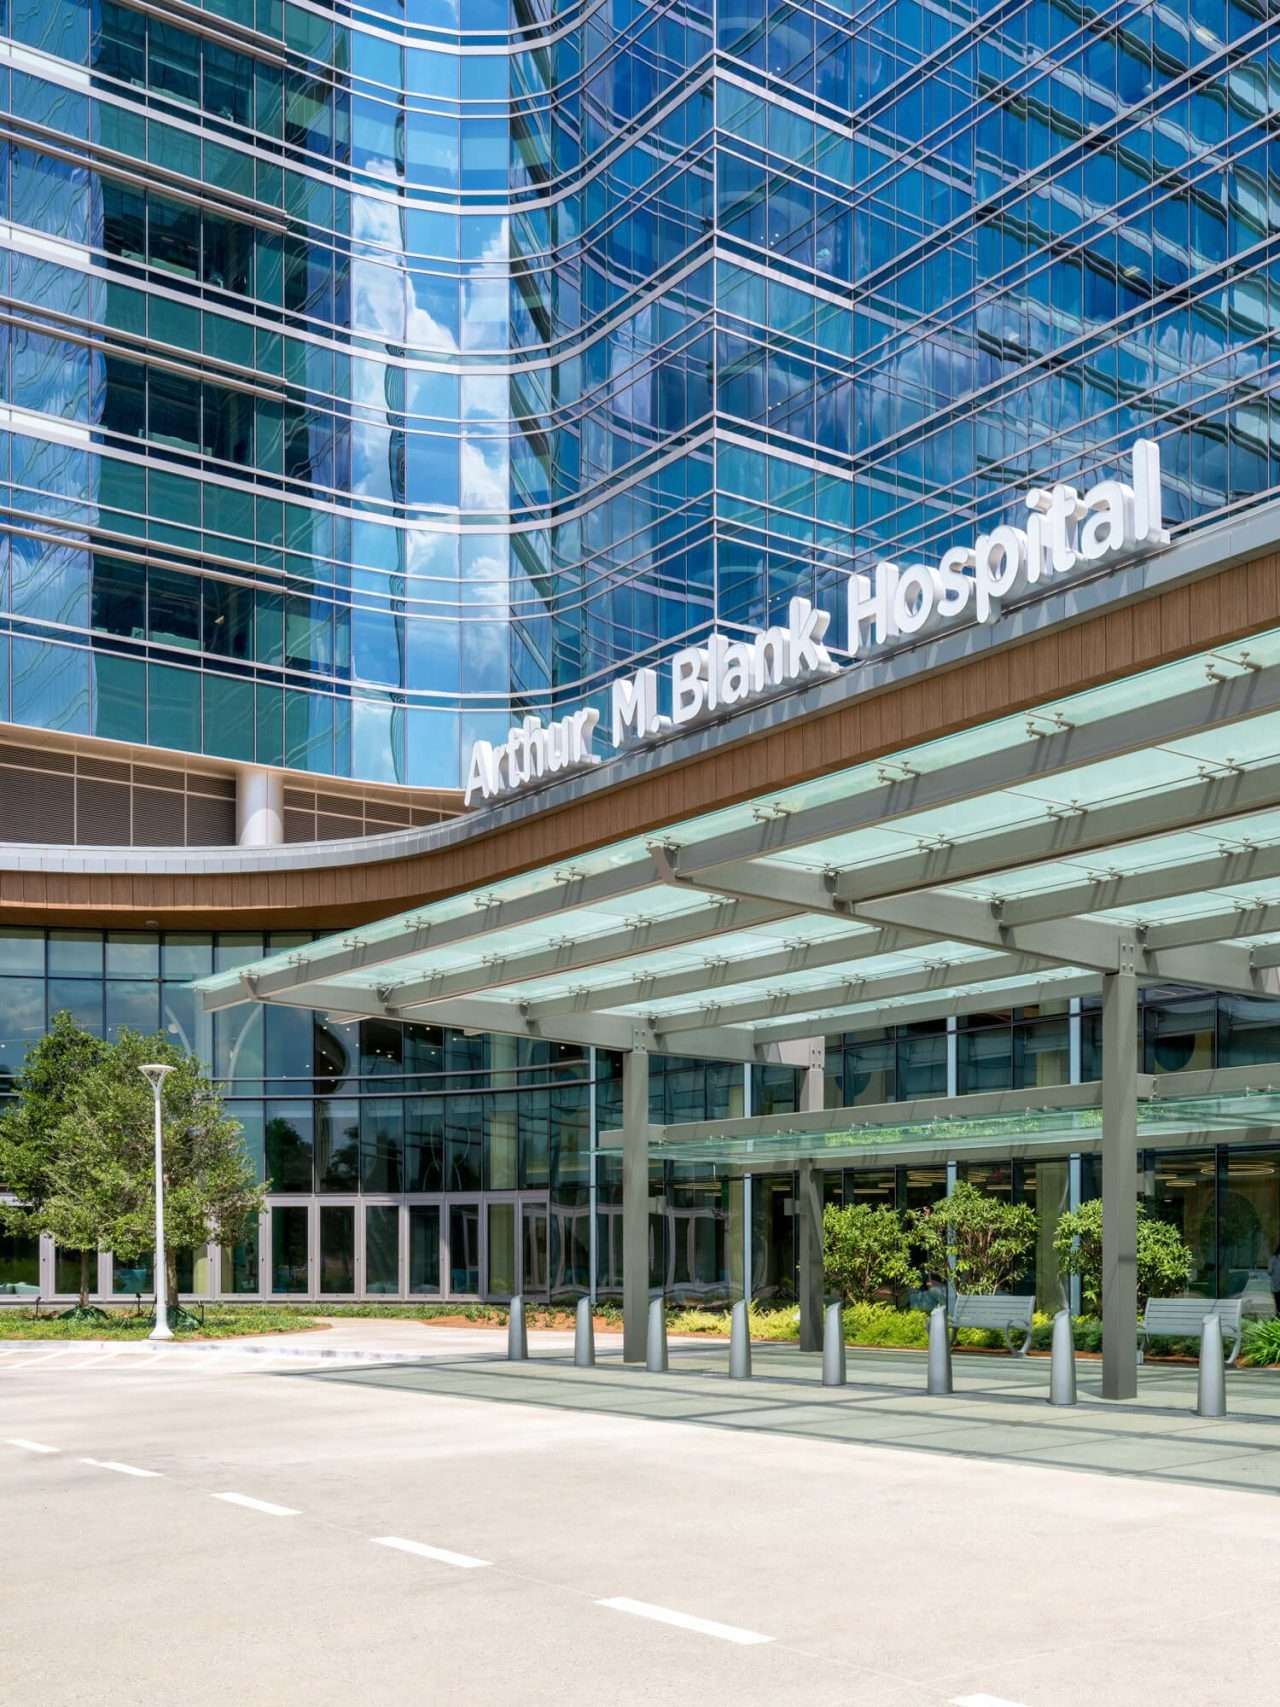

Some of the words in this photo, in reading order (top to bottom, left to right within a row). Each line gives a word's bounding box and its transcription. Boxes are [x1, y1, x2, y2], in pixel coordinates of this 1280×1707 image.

[464, 707, 600, 806] Arthur
[612, 667, 672, 748] M.
[672, 596, 838, 724] Blank
[848, 438, 1166, 657] Hospital
